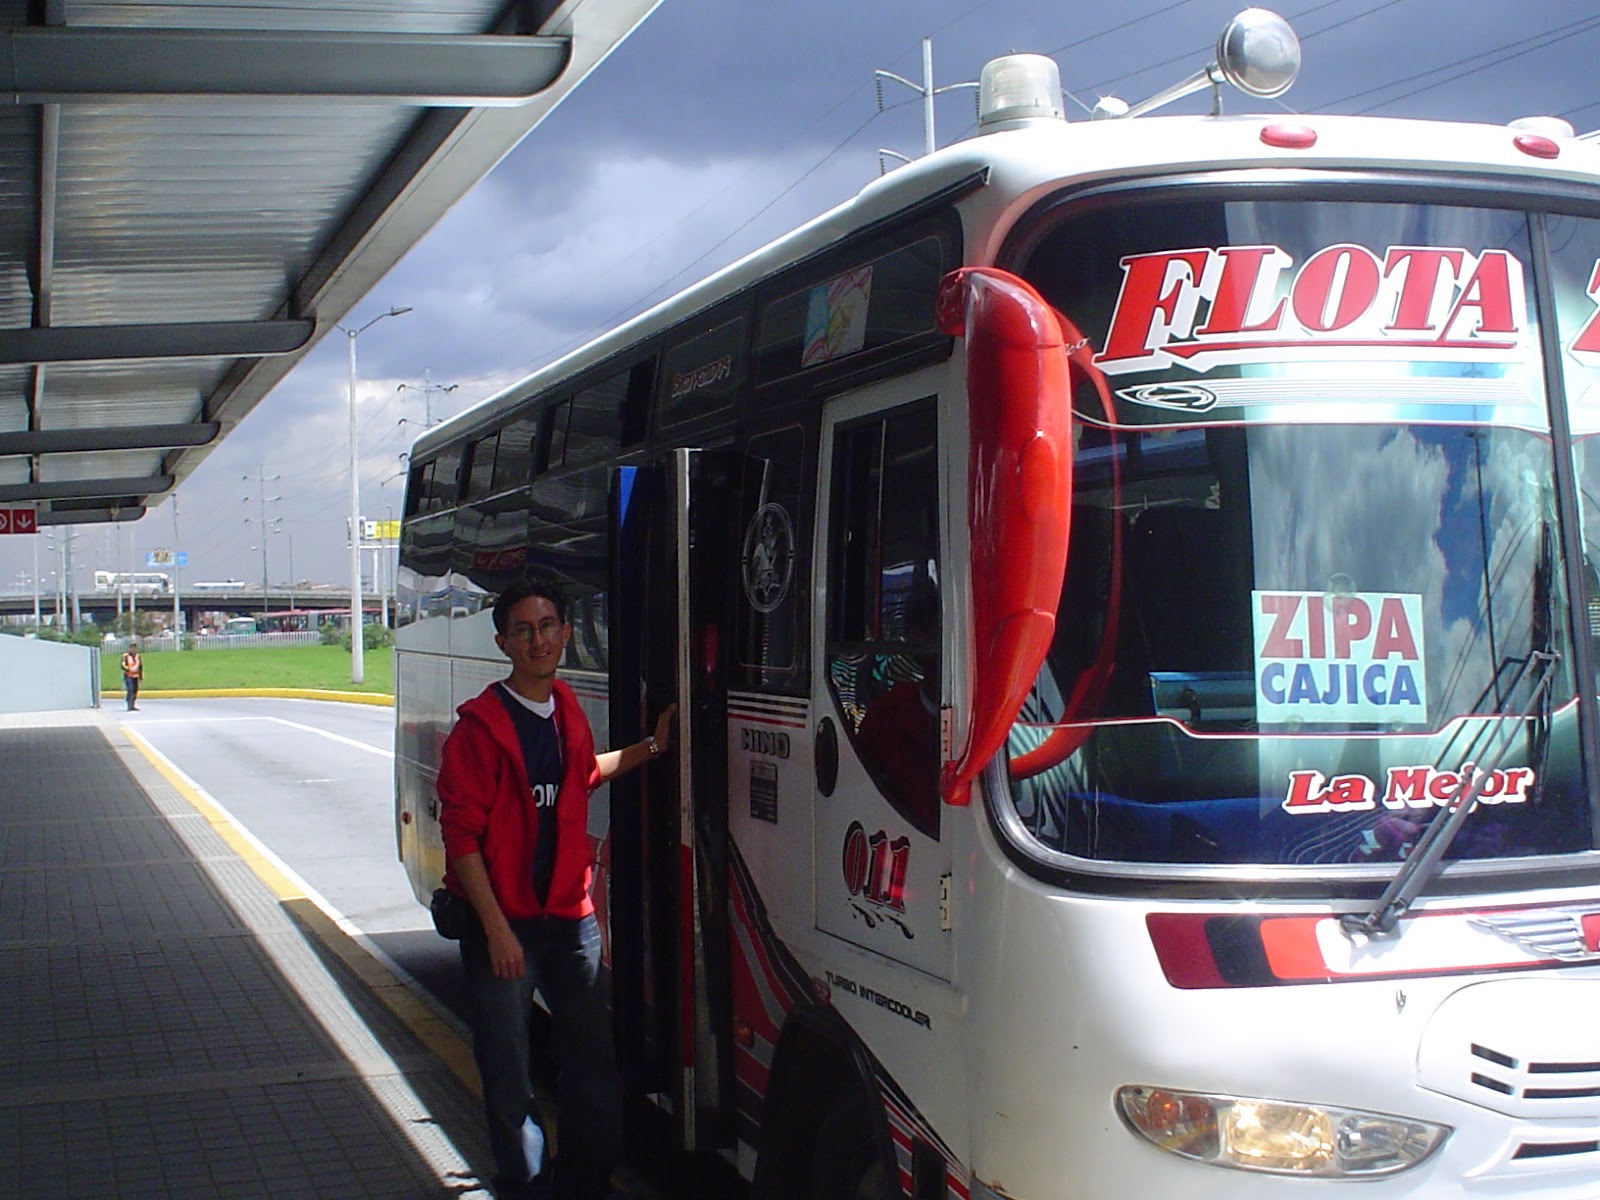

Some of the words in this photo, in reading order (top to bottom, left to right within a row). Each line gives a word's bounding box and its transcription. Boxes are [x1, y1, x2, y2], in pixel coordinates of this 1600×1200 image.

[1093, 243, 1524, 374] FLOTA
[1259, 595, 1419, 660] ZIPA
[1260, 662, 1421, 705] CAJICA
[741, 727, 790, 759] HINO
[530, 783, 560, 808] OM
[1282, 771, 1376, 815] La
[1383, 762, 1535, 814] Mejor
[842, 820, 910, 914] 011
[825, 970, 857, 994] TURBO
[859, 984, 932, 1031] INTERCOOLER
